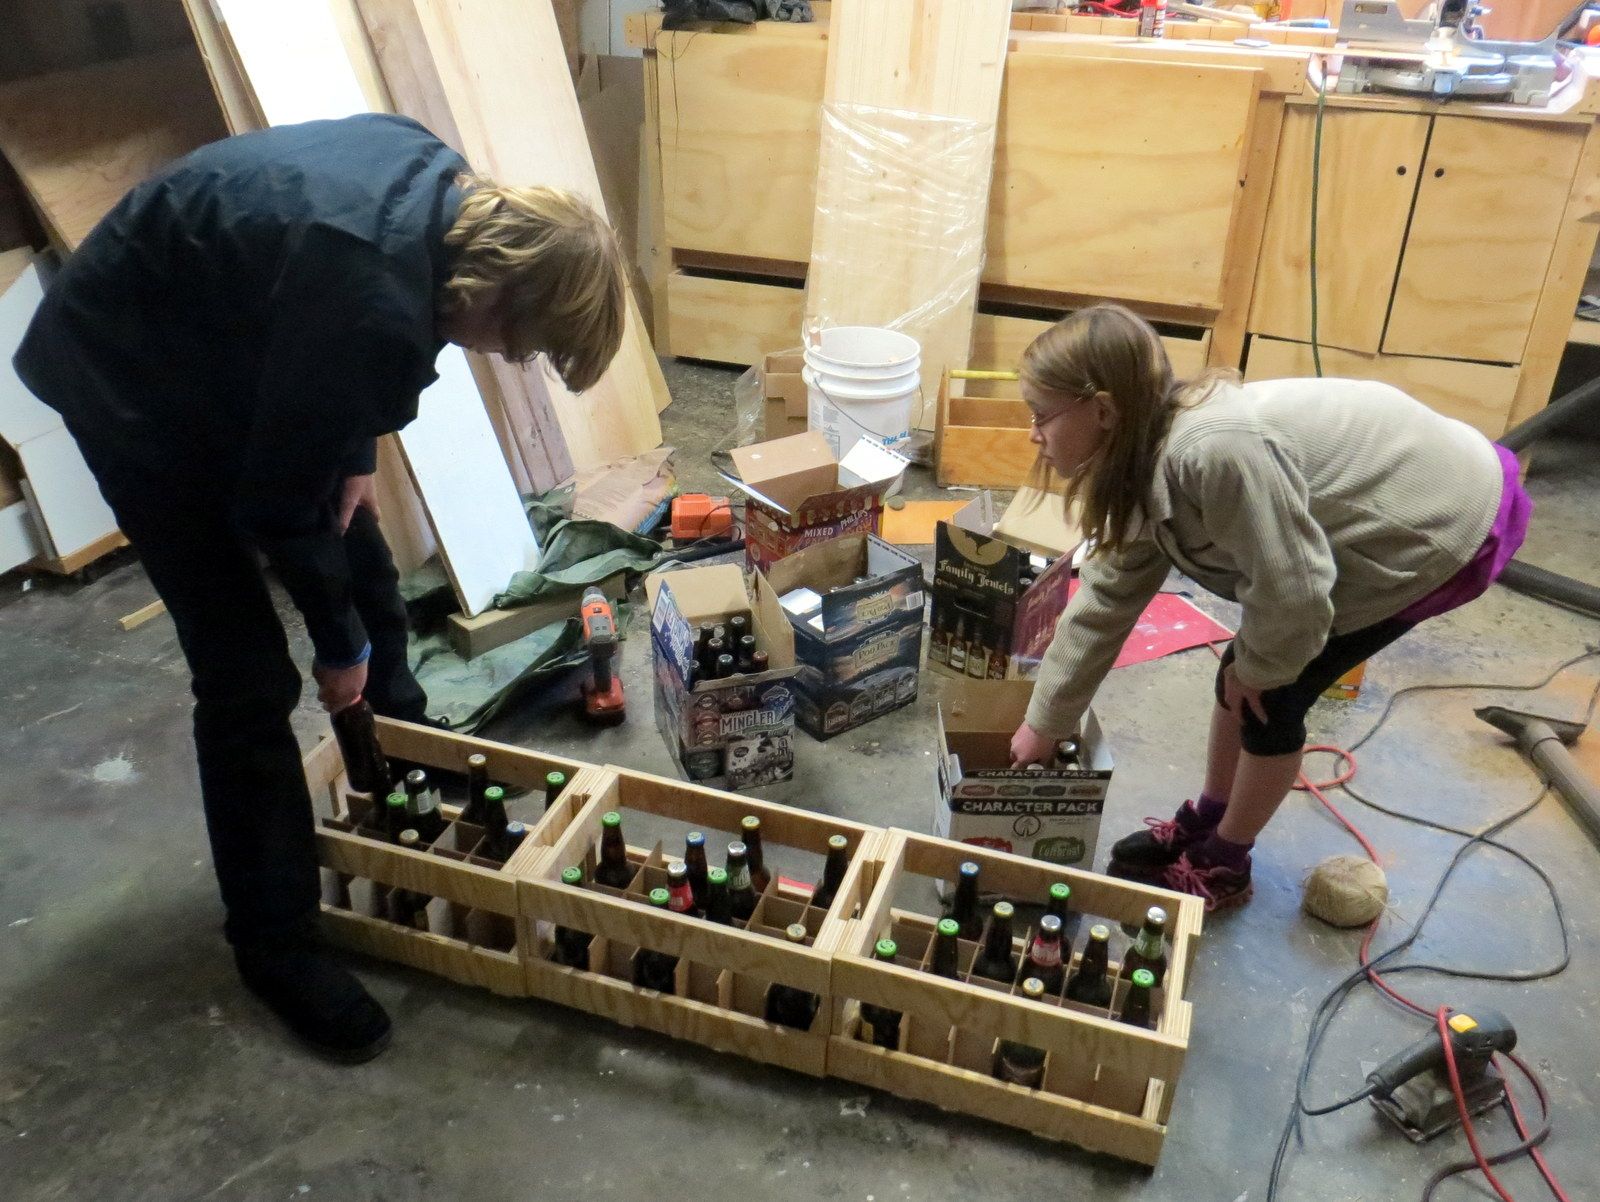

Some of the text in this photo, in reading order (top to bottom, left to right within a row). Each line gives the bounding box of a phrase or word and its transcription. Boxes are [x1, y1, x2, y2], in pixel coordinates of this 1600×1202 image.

[804, 527, 834, 538] MIXED
[721, 710, 775, 733] MINGLER
[977, 770, 1058, 778] CHARACTER
[962, 801, 1098, 813] CHARACTER PACK
